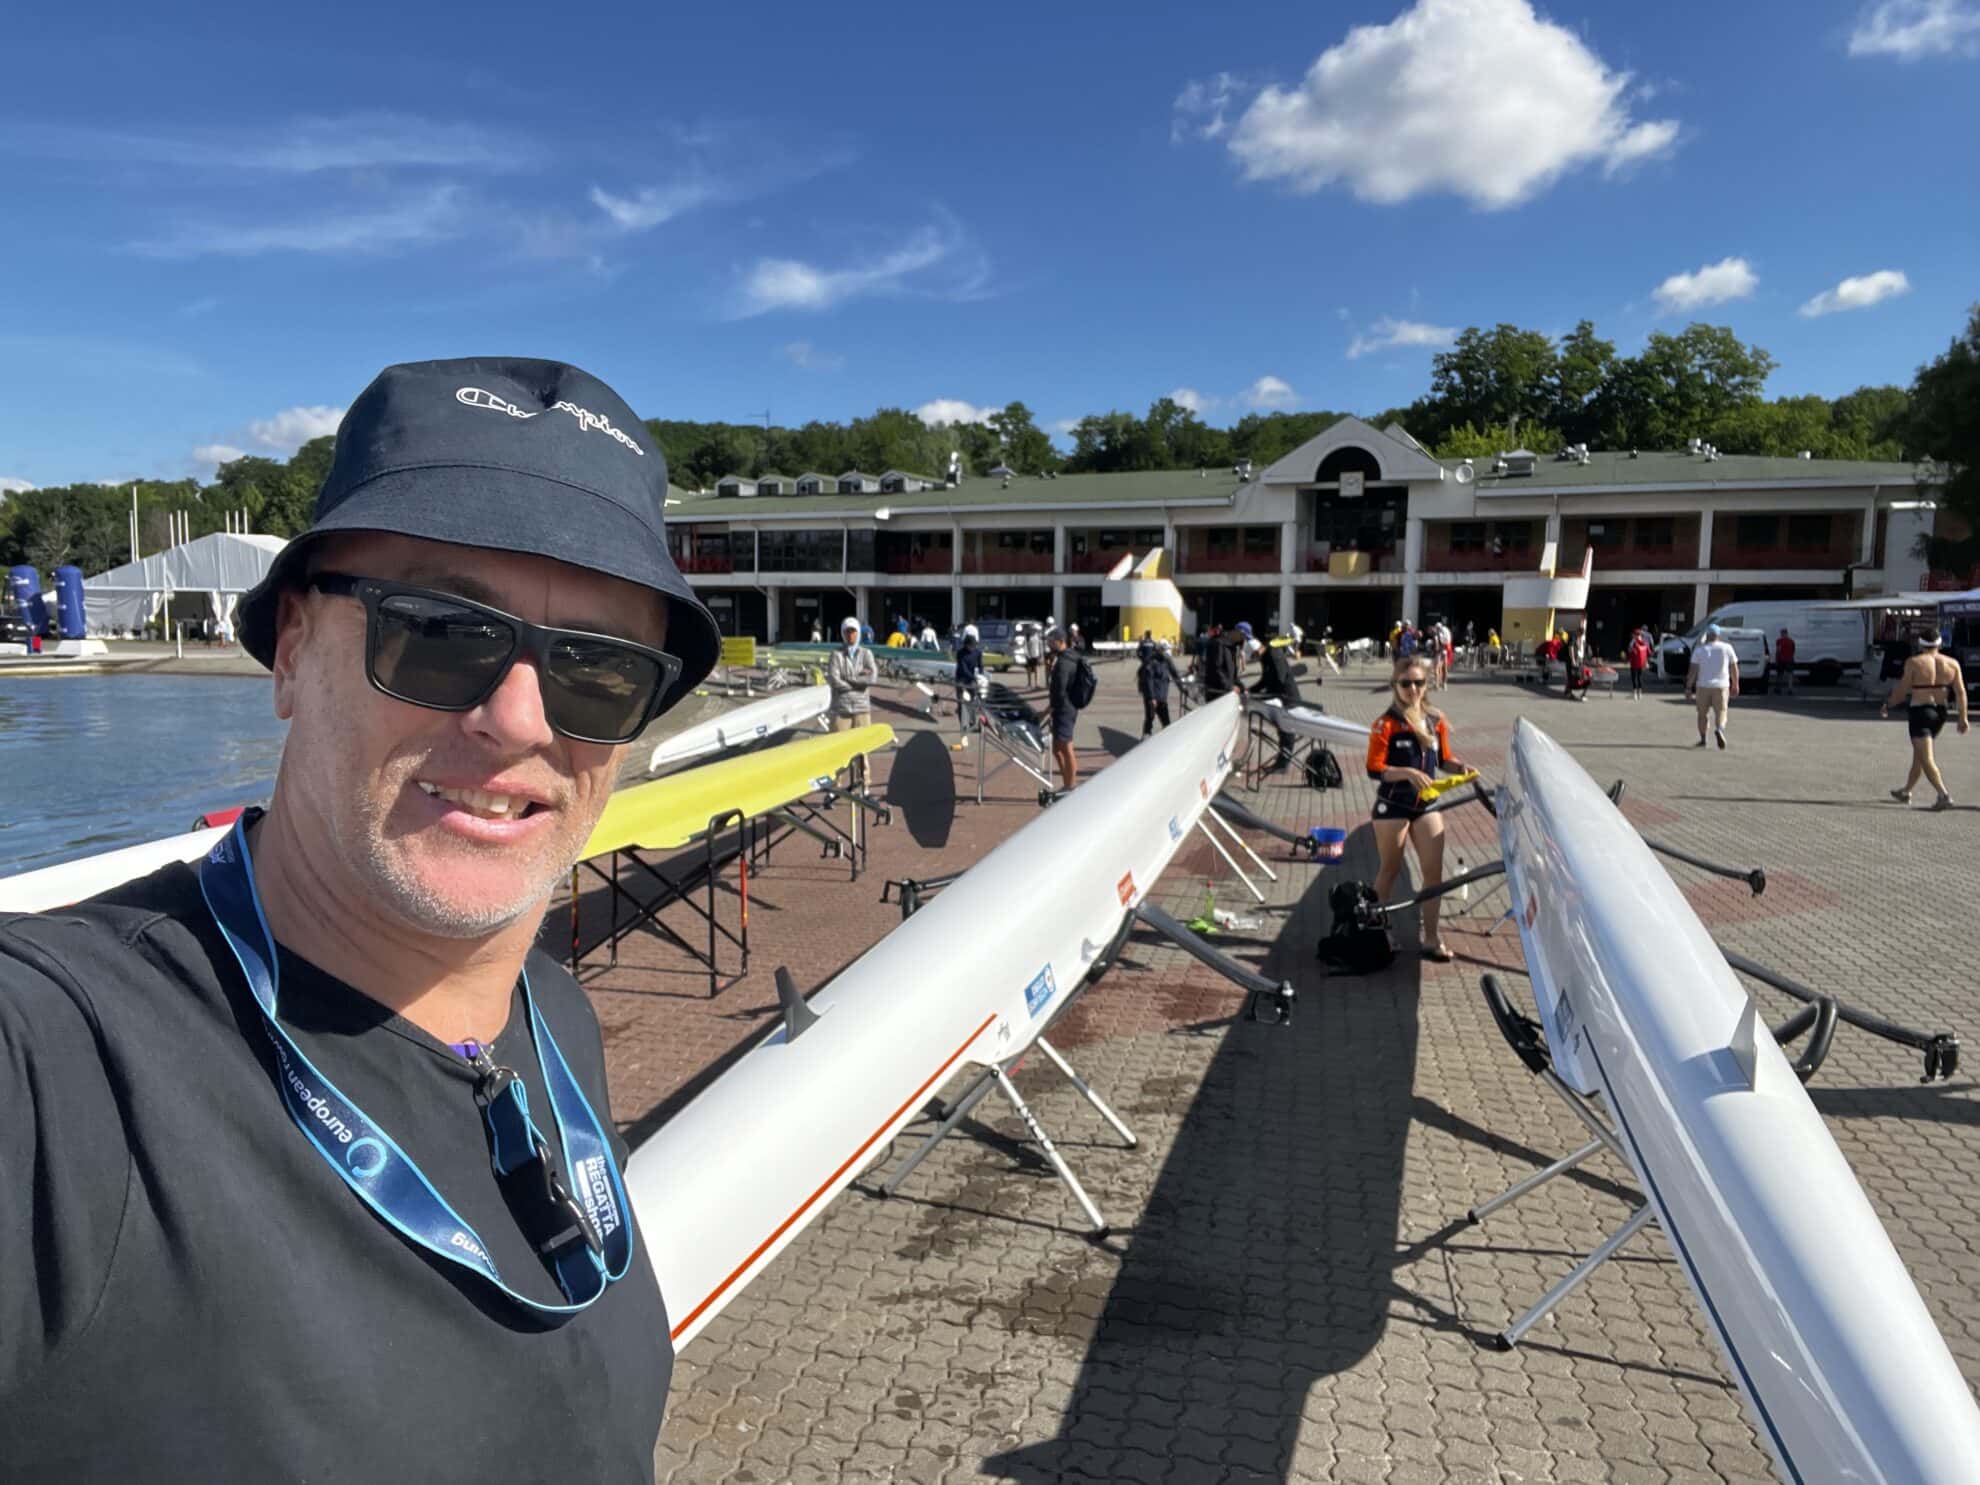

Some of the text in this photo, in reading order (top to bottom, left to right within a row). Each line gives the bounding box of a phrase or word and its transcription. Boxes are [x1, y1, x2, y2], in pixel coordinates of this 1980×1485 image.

[455, 387, 644, 456] Chmpion
[287, 1068, 353, 1144] european
[585, 1156, 617, 1237] REGATTA
[595, 1154, 608, 1176] the
